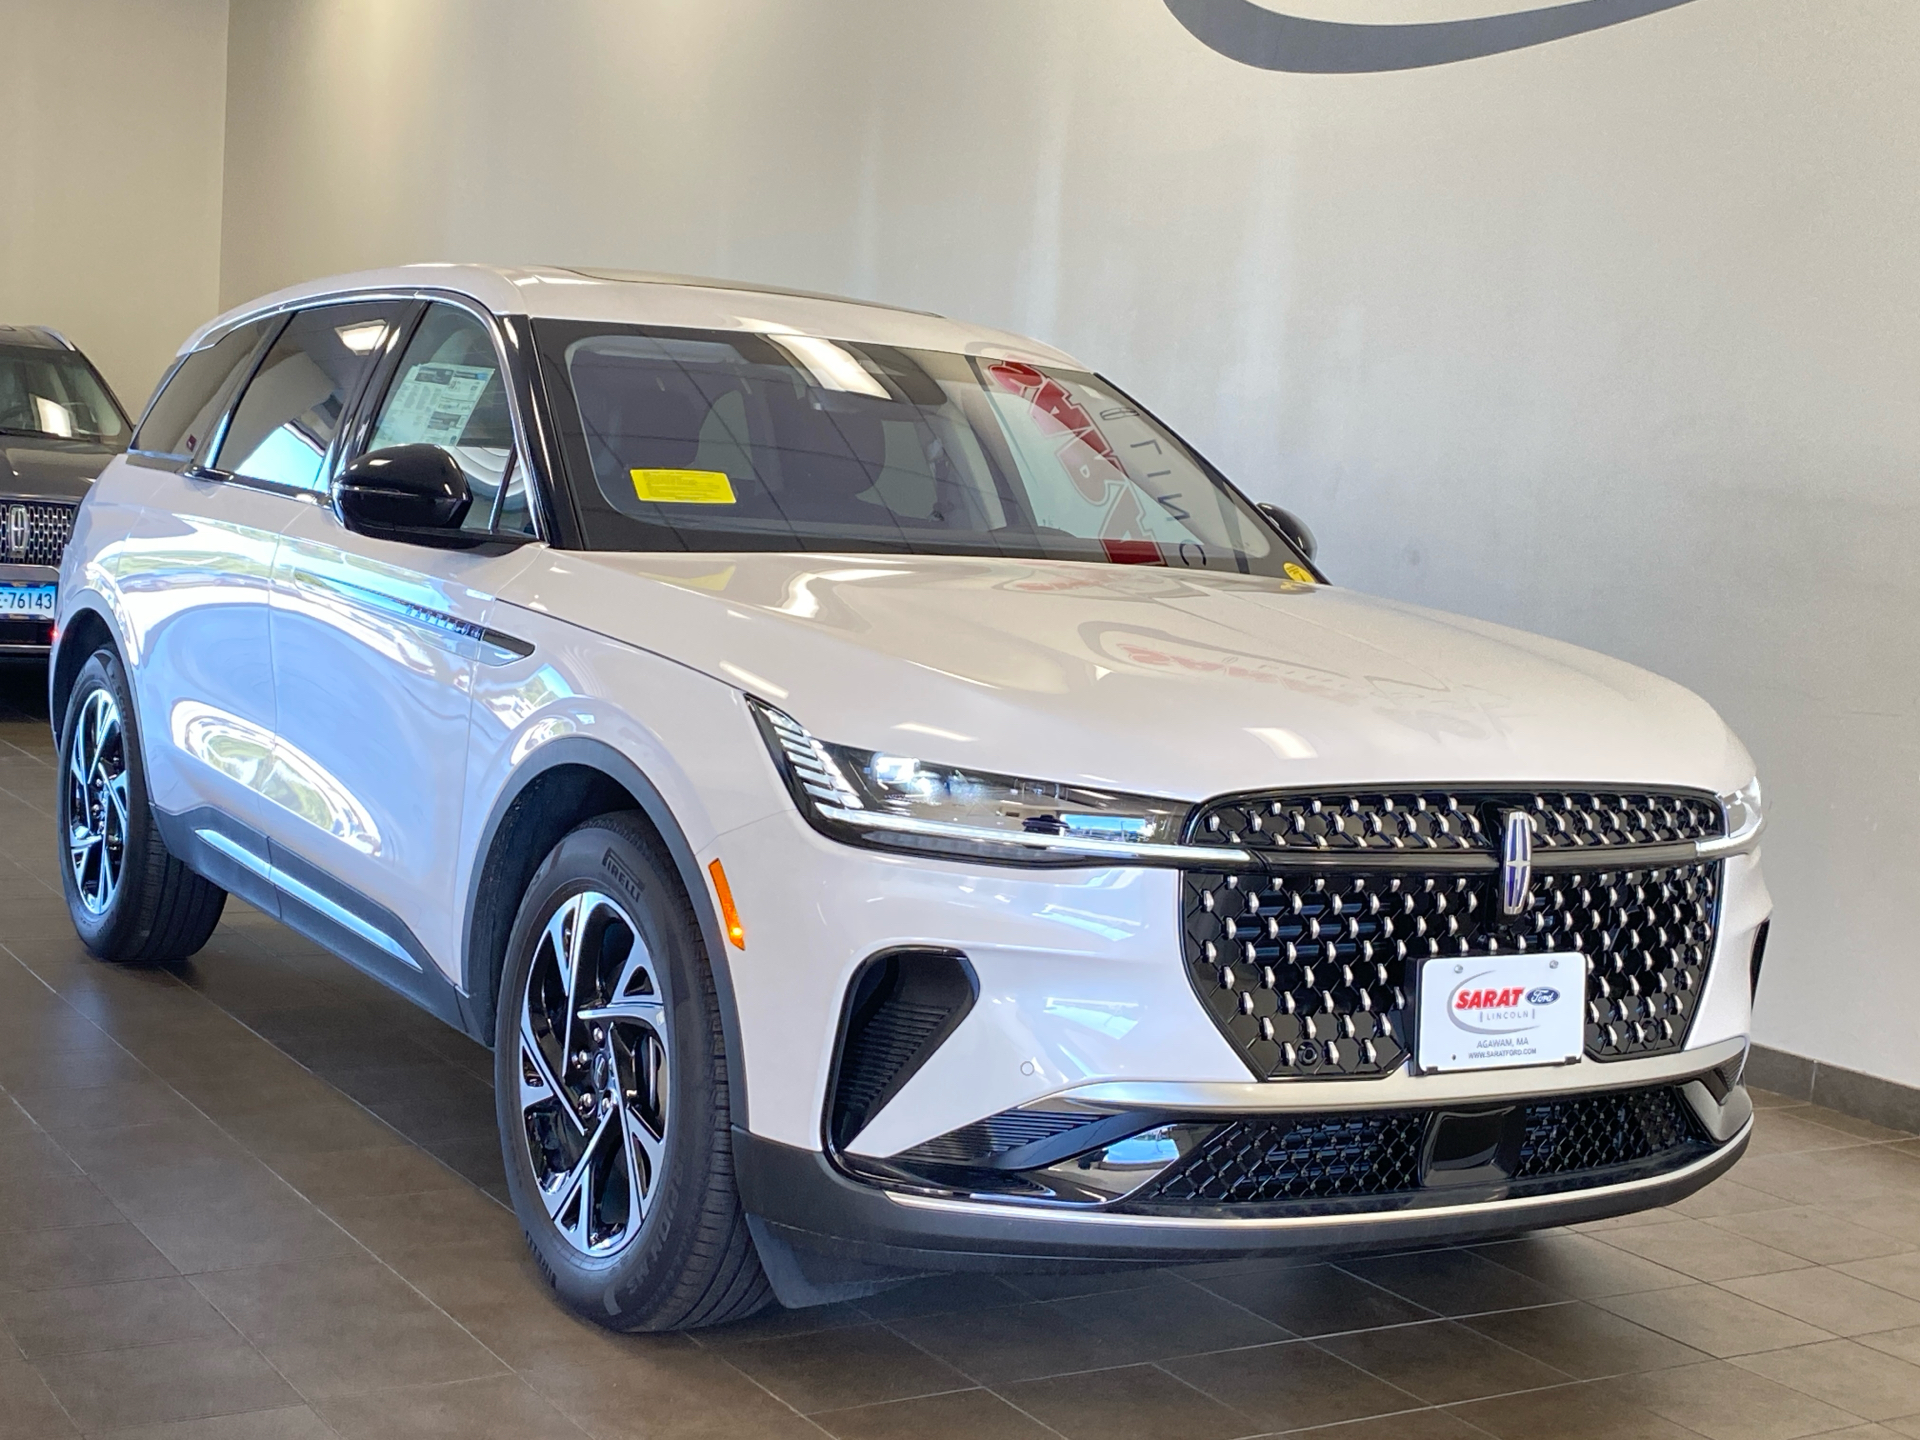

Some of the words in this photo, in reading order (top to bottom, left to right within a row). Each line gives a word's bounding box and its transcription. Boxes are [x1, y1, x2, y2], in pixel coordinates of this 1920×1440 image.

[601, 846, 645, 903] PIRELLI
[1455, 986, 1525, 1010] SARAT
[1528, 988, 1557, 1004] Ford
[1486, 1011, 1529, 1020] LINCOLN
[1476, 1039, 1515, 1049] AGAWAM,
[1516, 1037, 1529, 1046] MA
[1468, 1048, 1537, 1059] WWW.SARATFORD.COM
